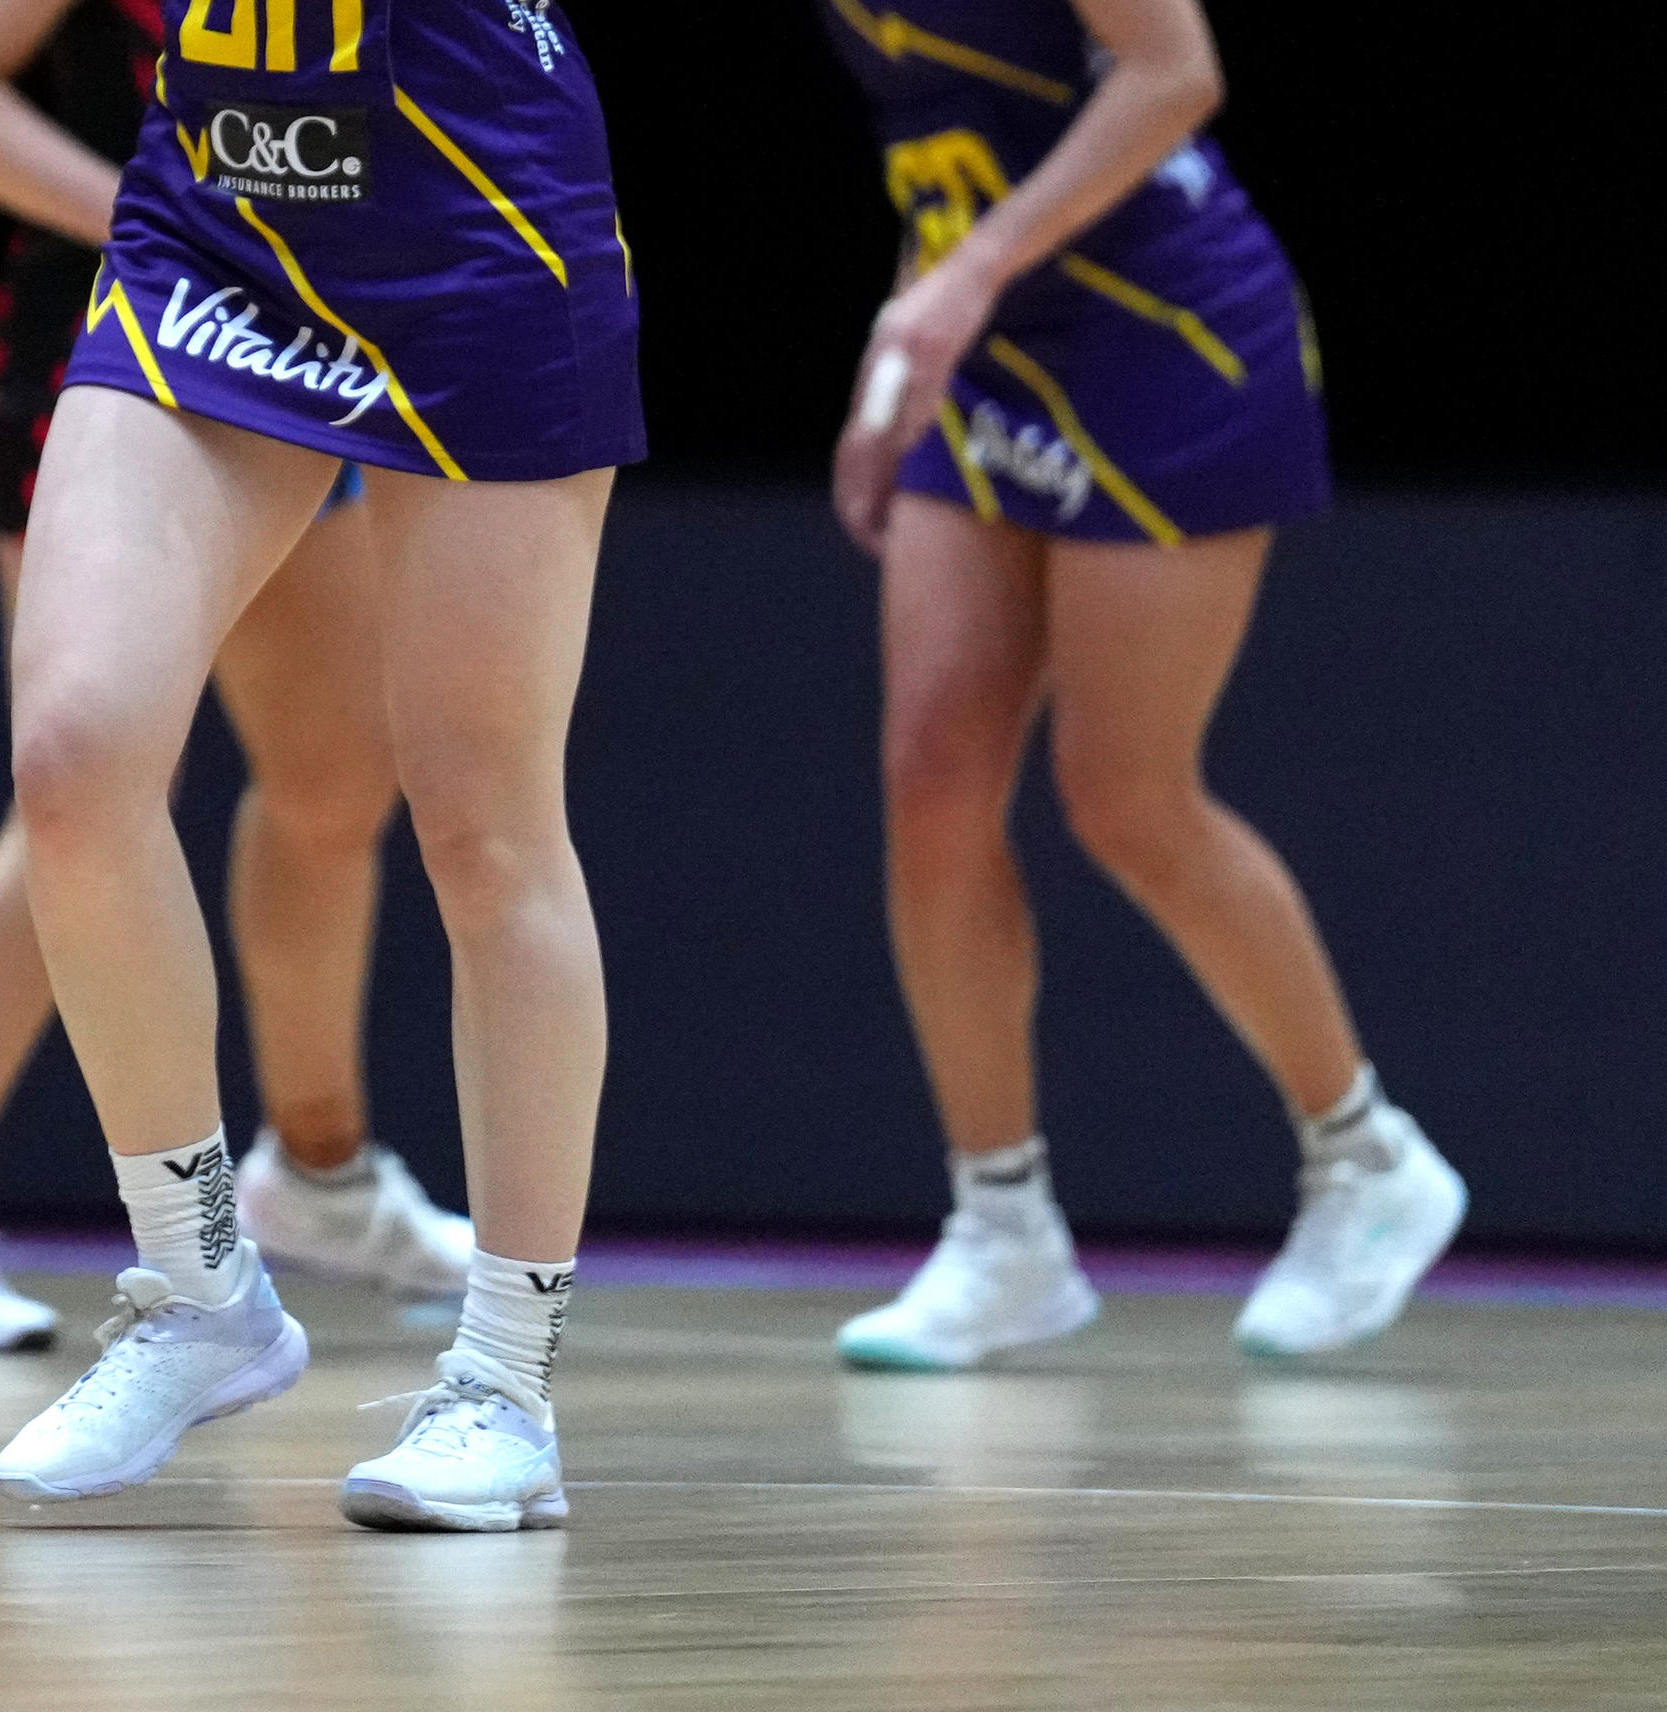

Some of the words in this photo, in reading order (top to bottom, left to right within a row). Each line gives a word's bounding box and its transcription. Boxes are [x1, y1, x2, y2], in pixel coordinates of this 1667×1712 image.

[217, 174, 283, 197] INSURANCE
[288, 184, 362, 199] BROKERS
[157, 277, 390, 426] Vitality
